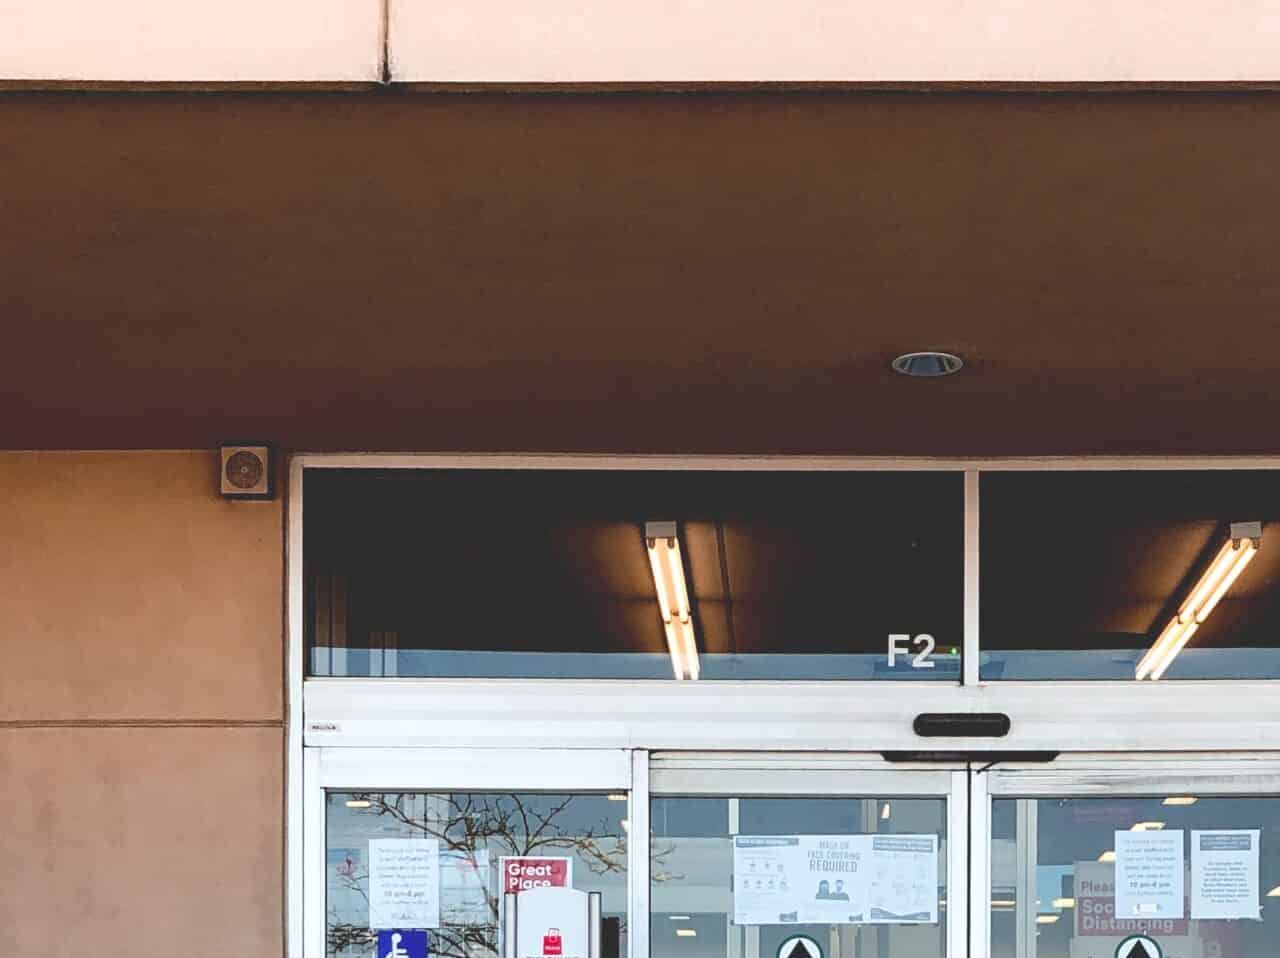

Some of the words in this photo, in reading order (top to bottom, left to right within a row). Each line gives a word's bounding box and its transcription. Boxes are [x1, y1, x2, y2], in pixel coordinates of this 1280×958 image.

[888, 633, 936, 668] F2
[509, 863, 553, 877] Great
[809, 859, 858, 873] REQUIRED
[1080, 880, 1115, 892] Pleas
[1082, 914, 1174, 932] Distancing
